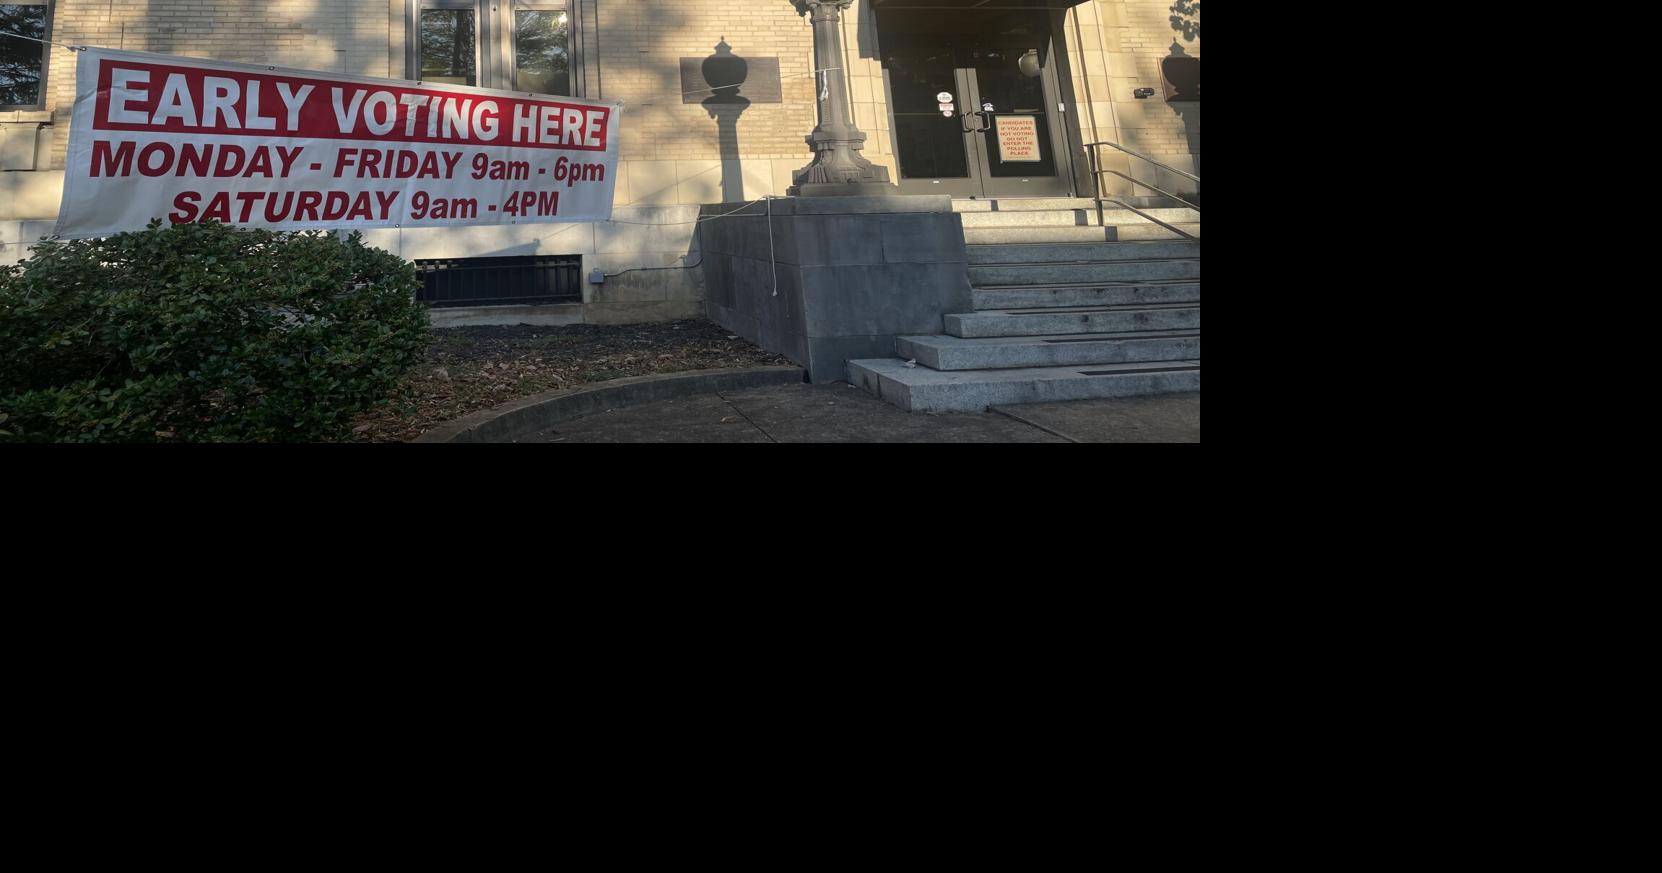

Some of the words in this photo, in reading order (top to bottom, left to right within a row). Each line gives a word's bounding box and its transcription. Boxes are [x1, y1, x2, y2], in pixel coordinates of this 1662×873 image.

[108, 68, 315, 131] EARLY
[331, 87, 499, 141] VOTING
[512, 104, 605, 147] HERE
[90, 140, 304, 178] MONDAY
[333, 148, 463, 179] FRIDAY
[471, 152, 529, 180] 9am
[554, 156, 605, 187] 6pm
[169, 191, 400, 223] SATURDAY
[410, 190, 477, 219] 9am
[503, 191, 559, 217] 4PM
